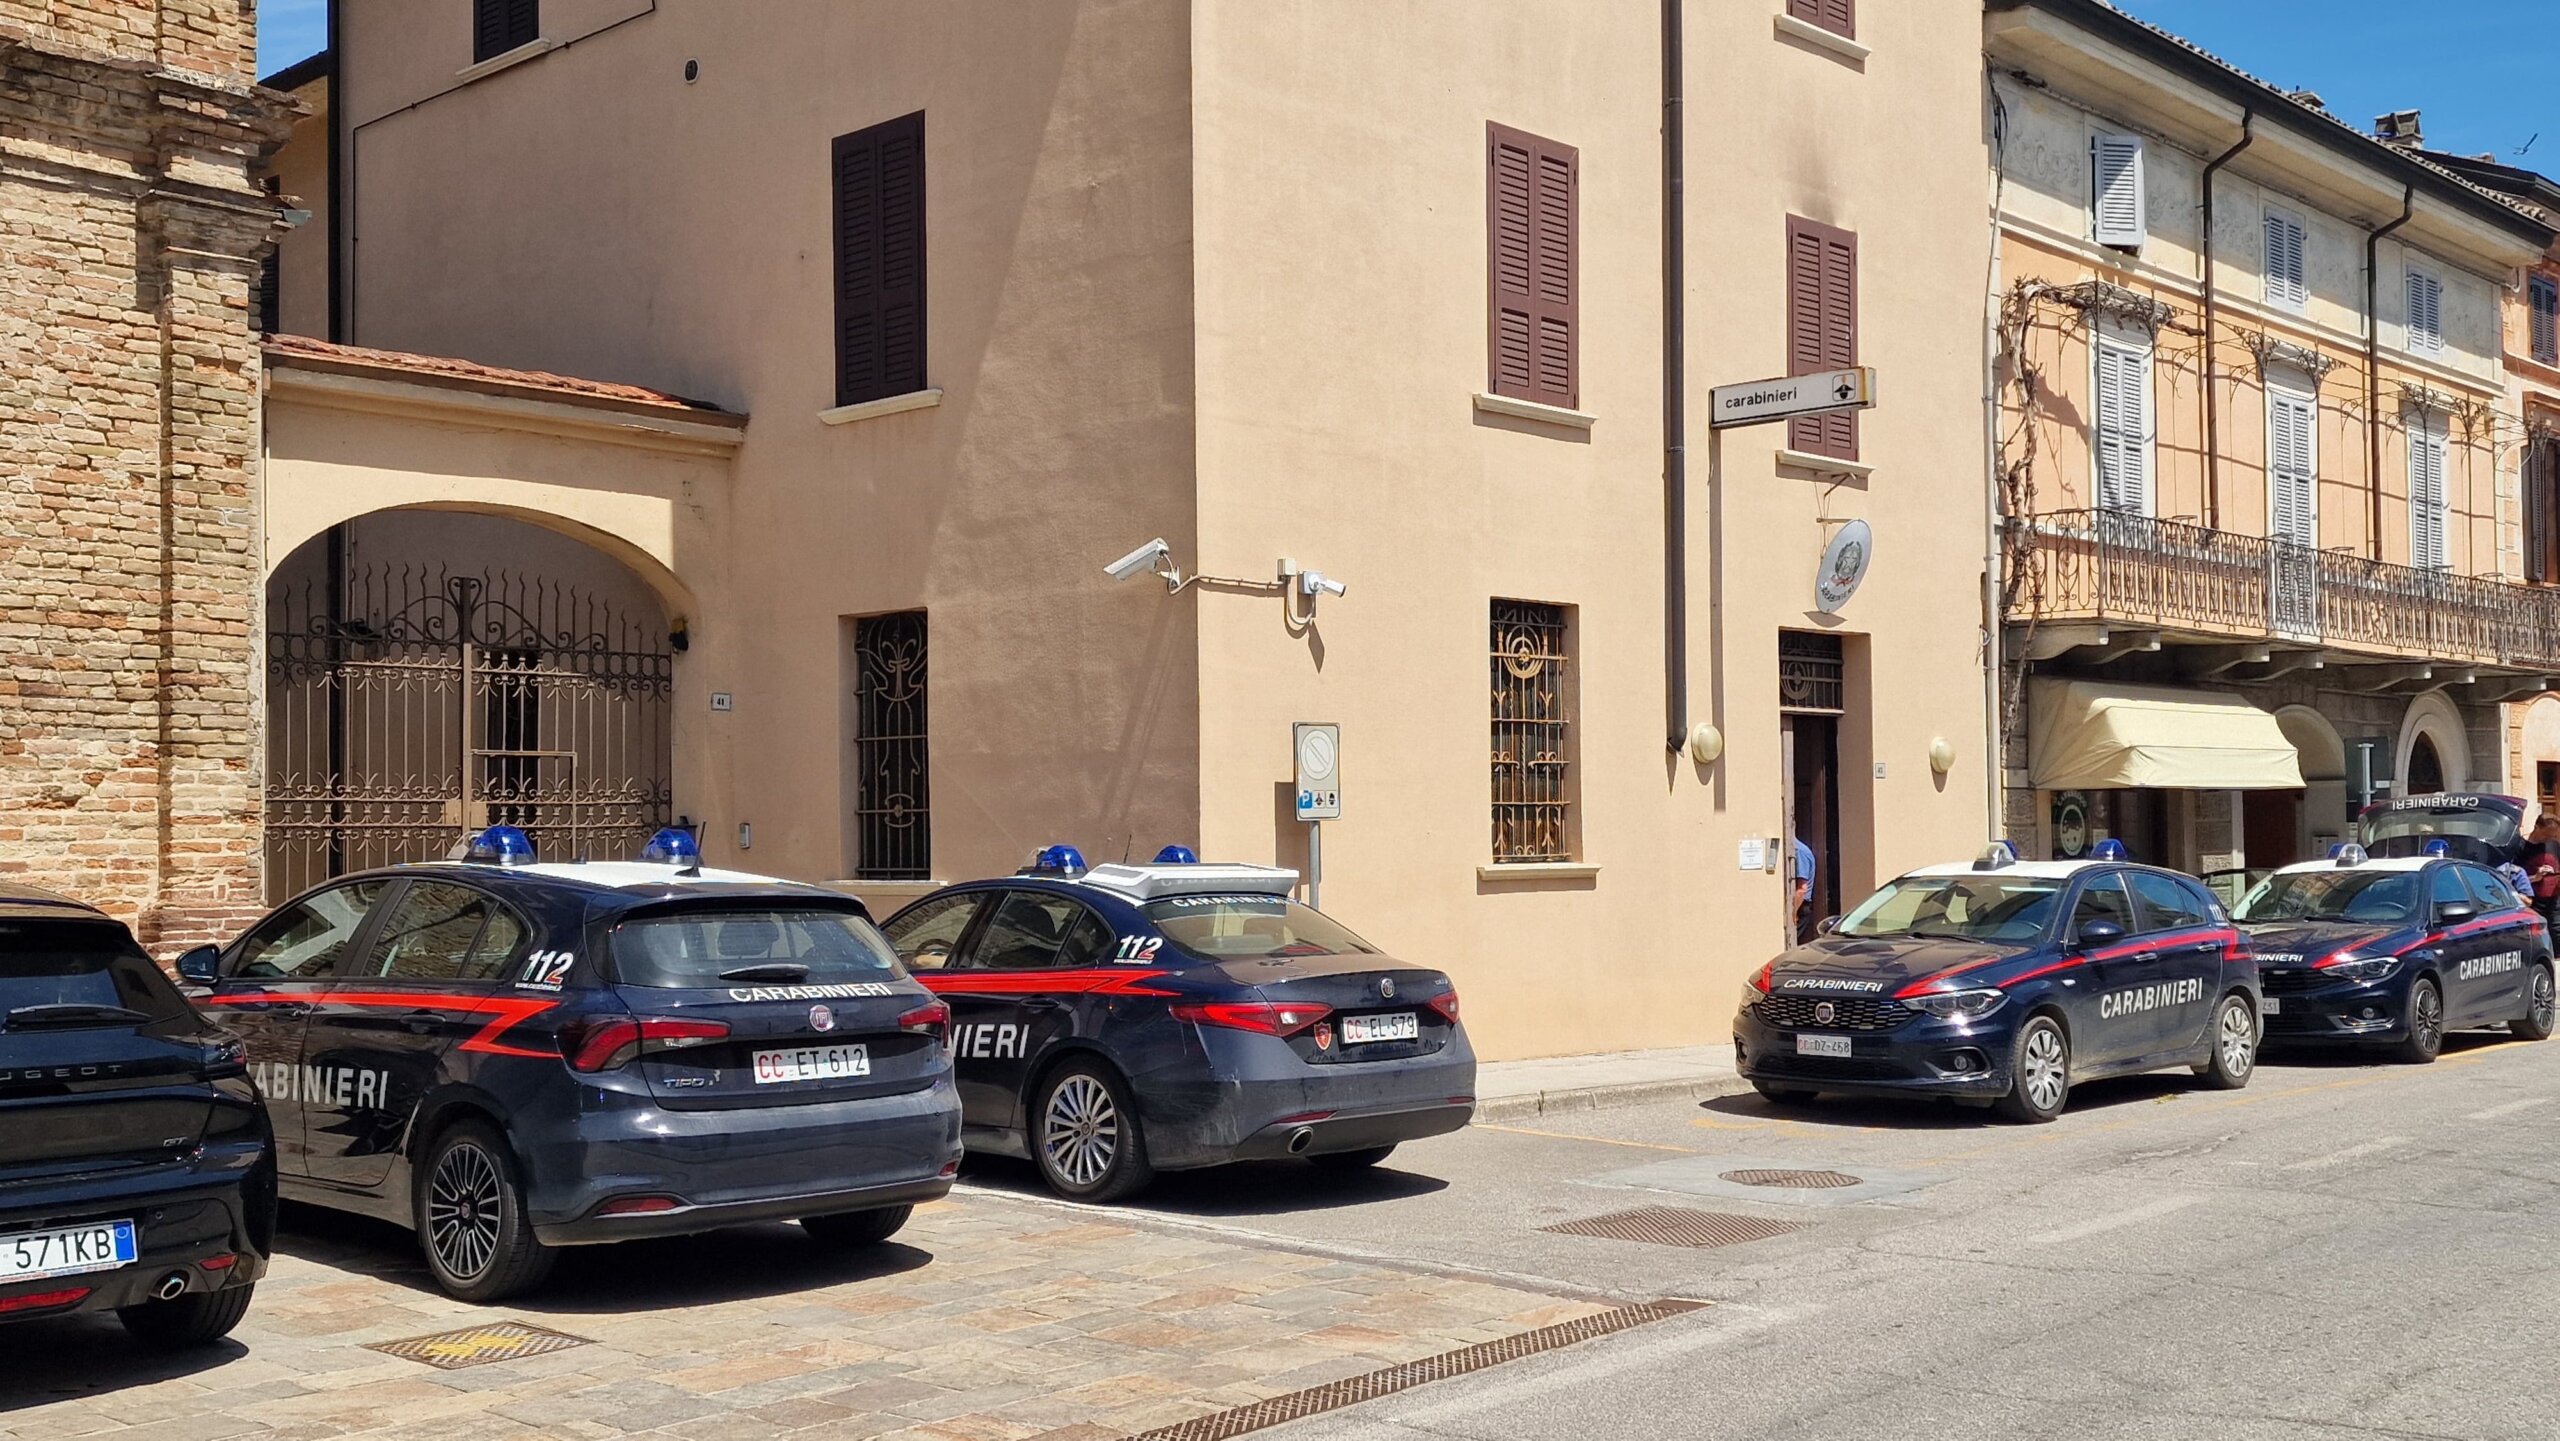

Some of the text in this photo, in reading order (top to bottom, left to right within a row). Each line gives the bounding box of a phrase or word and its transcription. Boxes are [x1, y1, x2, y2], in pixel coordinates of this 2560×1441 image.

[1725, 386, 1797, 409] carabinieri
[2392, 796, 2480, 811] CARABINIERI
[1116, 934, 1163, 960] 112
[522, 949, 574, 985] 112
[2460, 950, 2521, 980] CARABINIERI
[728, 982, 893, 1002] CARABINIERI
[1783, 979, 1884, 993] CARABINIERI
[2101, 977, 2203, 1019] CARABINIERI
[1346, 1015, 1415, 1040] CC EL 579
[757, 1047, 866, 1079] CC ET 612
[248, 1061, 389, 1110] ABINIERI
[162, 1136, 188, 1147] GT
[15, 1229, 111, 1269] 571KB
